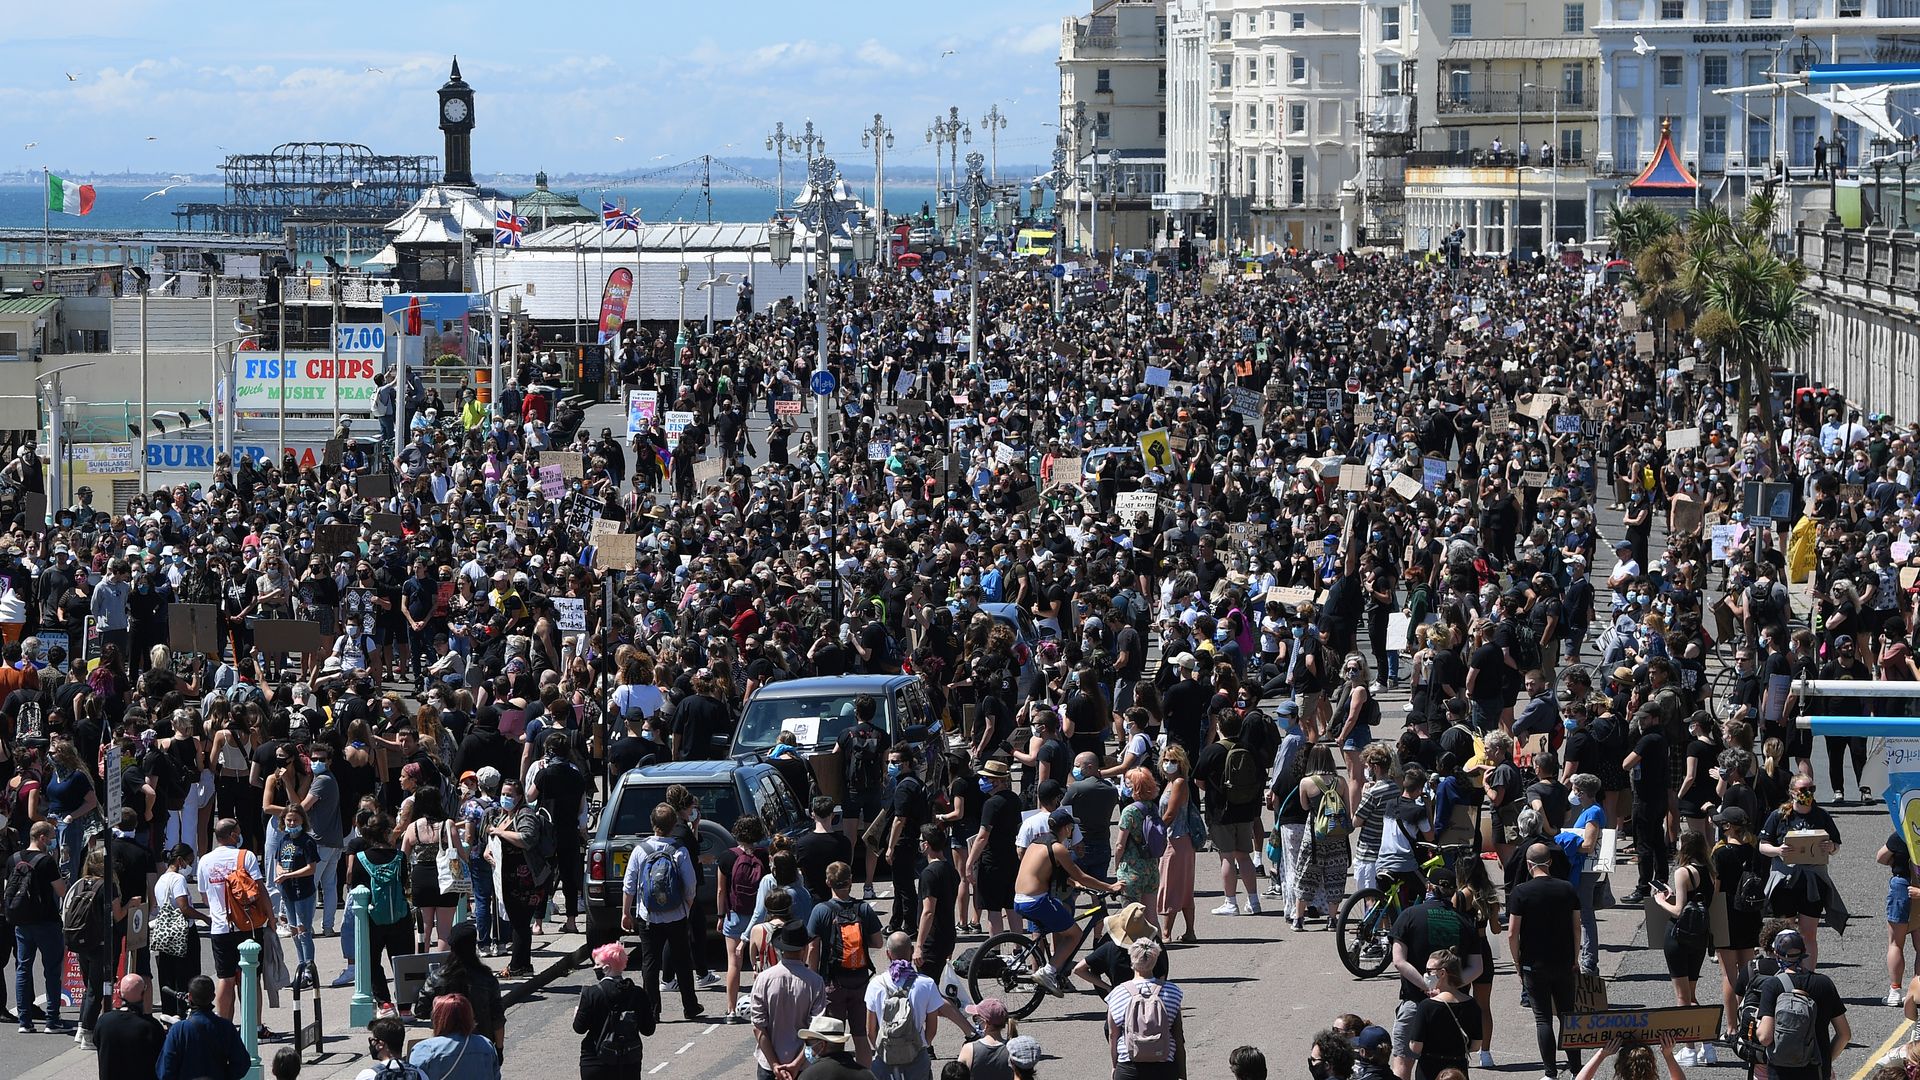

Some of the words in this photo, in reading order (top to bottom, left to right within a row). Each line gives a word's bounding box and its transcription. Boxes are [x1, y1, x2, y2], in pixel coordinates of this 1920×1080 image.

[1693, 34, 1731, 43] ROYAL
[1736, 32, 1781, 43] ALBION
[245, 360, 297, 379] FISH
[306, 359, 374, 379] CHIPS
[237, 383, 263, 397] With
[268, 387, 326, 400] MUSHY
[338, 387, 373, 400] PEAS
[596, 521, 617, 529] DEFUND
[598, 535, 634, 547] BLACK
[1564, 1016, 1582, 1029] UK
[1587, 1014, 1649, 1028] SCHOOLS
[1563, 1032, 1599, 1043] TEACH
